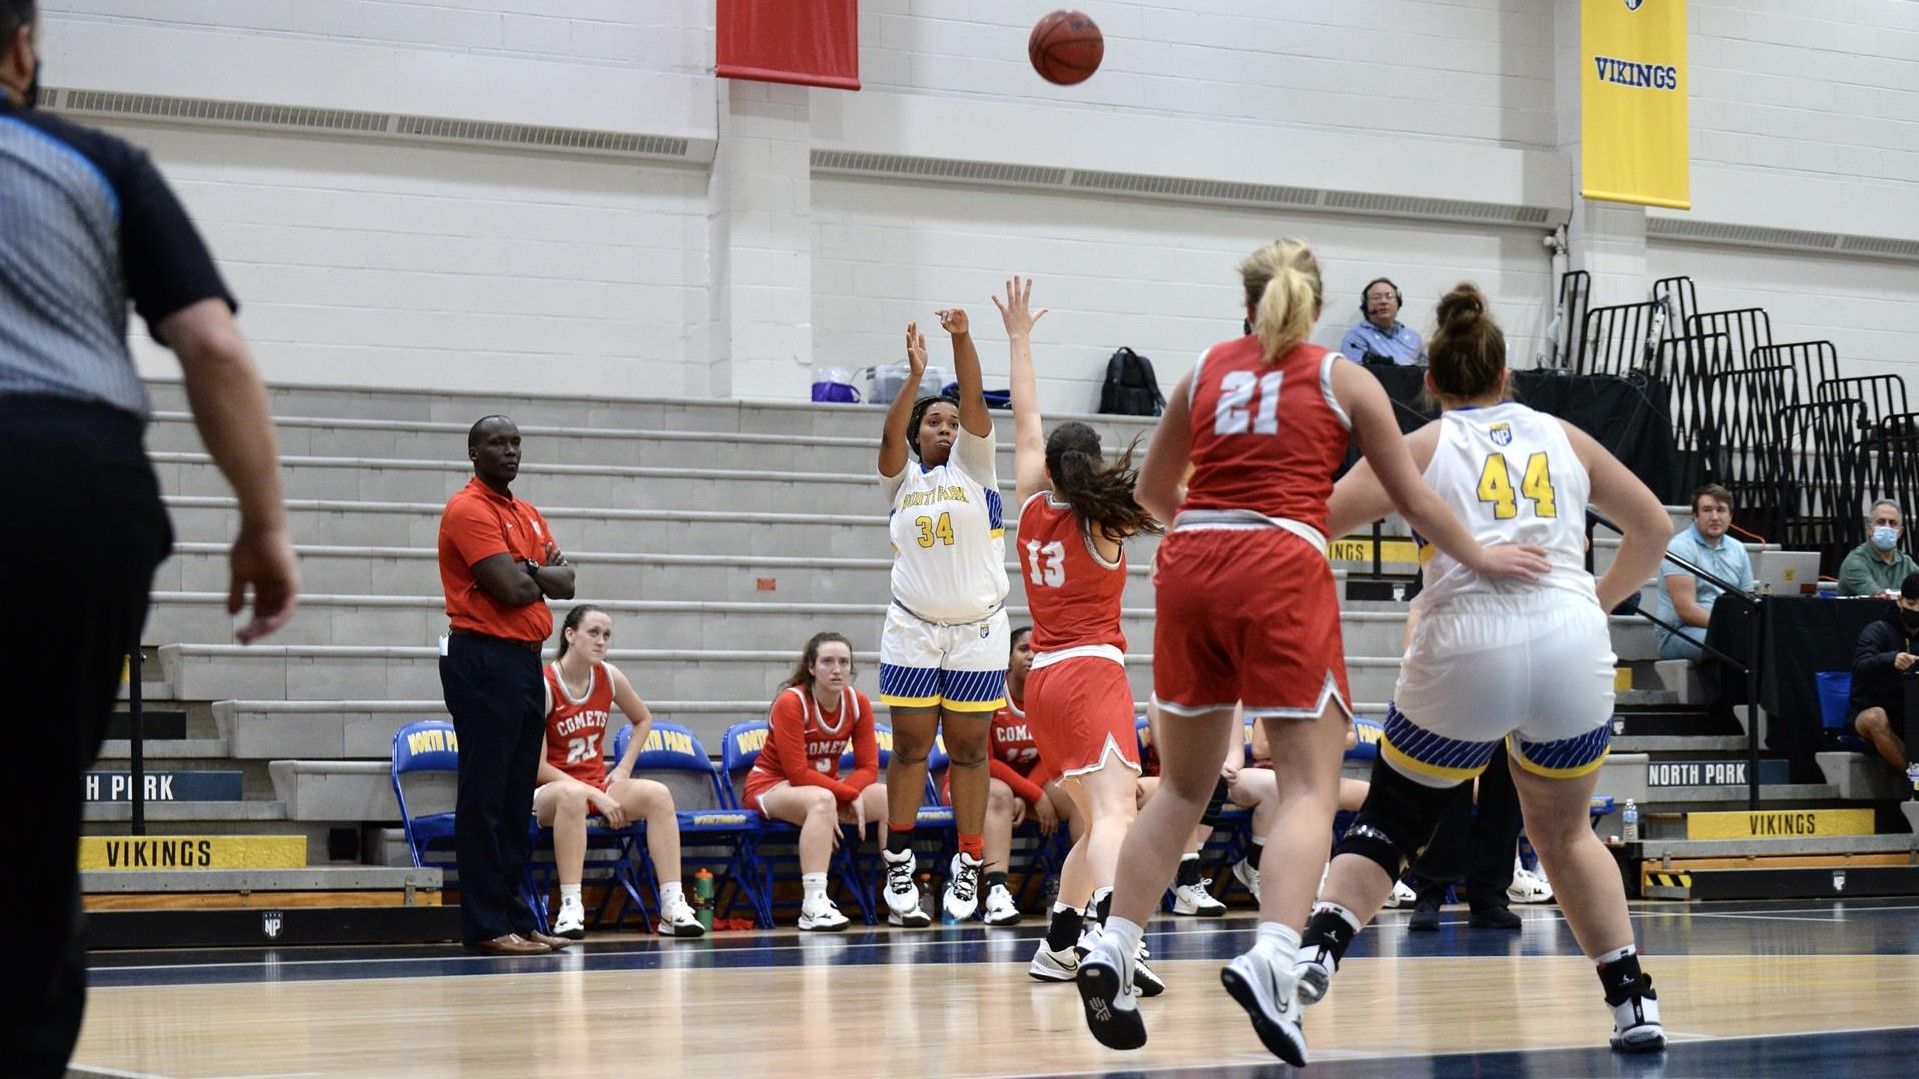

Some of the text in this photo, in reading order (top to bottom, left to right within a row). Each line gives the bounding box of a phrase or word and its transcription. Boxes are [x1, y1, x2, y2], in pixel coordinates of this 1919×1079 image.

[1594, 56, 1677, 90] VIKINGS
[1214, 370, 1284, 436] 21
[1476, 451, 1557, 519] 44
[915, 511, 954, 548] 34
[1026, 538, 1066, 587] 13
[1328, 543, 1364, 560] INGS
[557, 710, 608, 736] COMETS
[1649, 763, 1747, 786] NORTH PARK
[1750, 814, 1816, 835] VIKINGS
[106, 840, 211, 867] VIKINGS
[264, 918, 281, 937] NP
